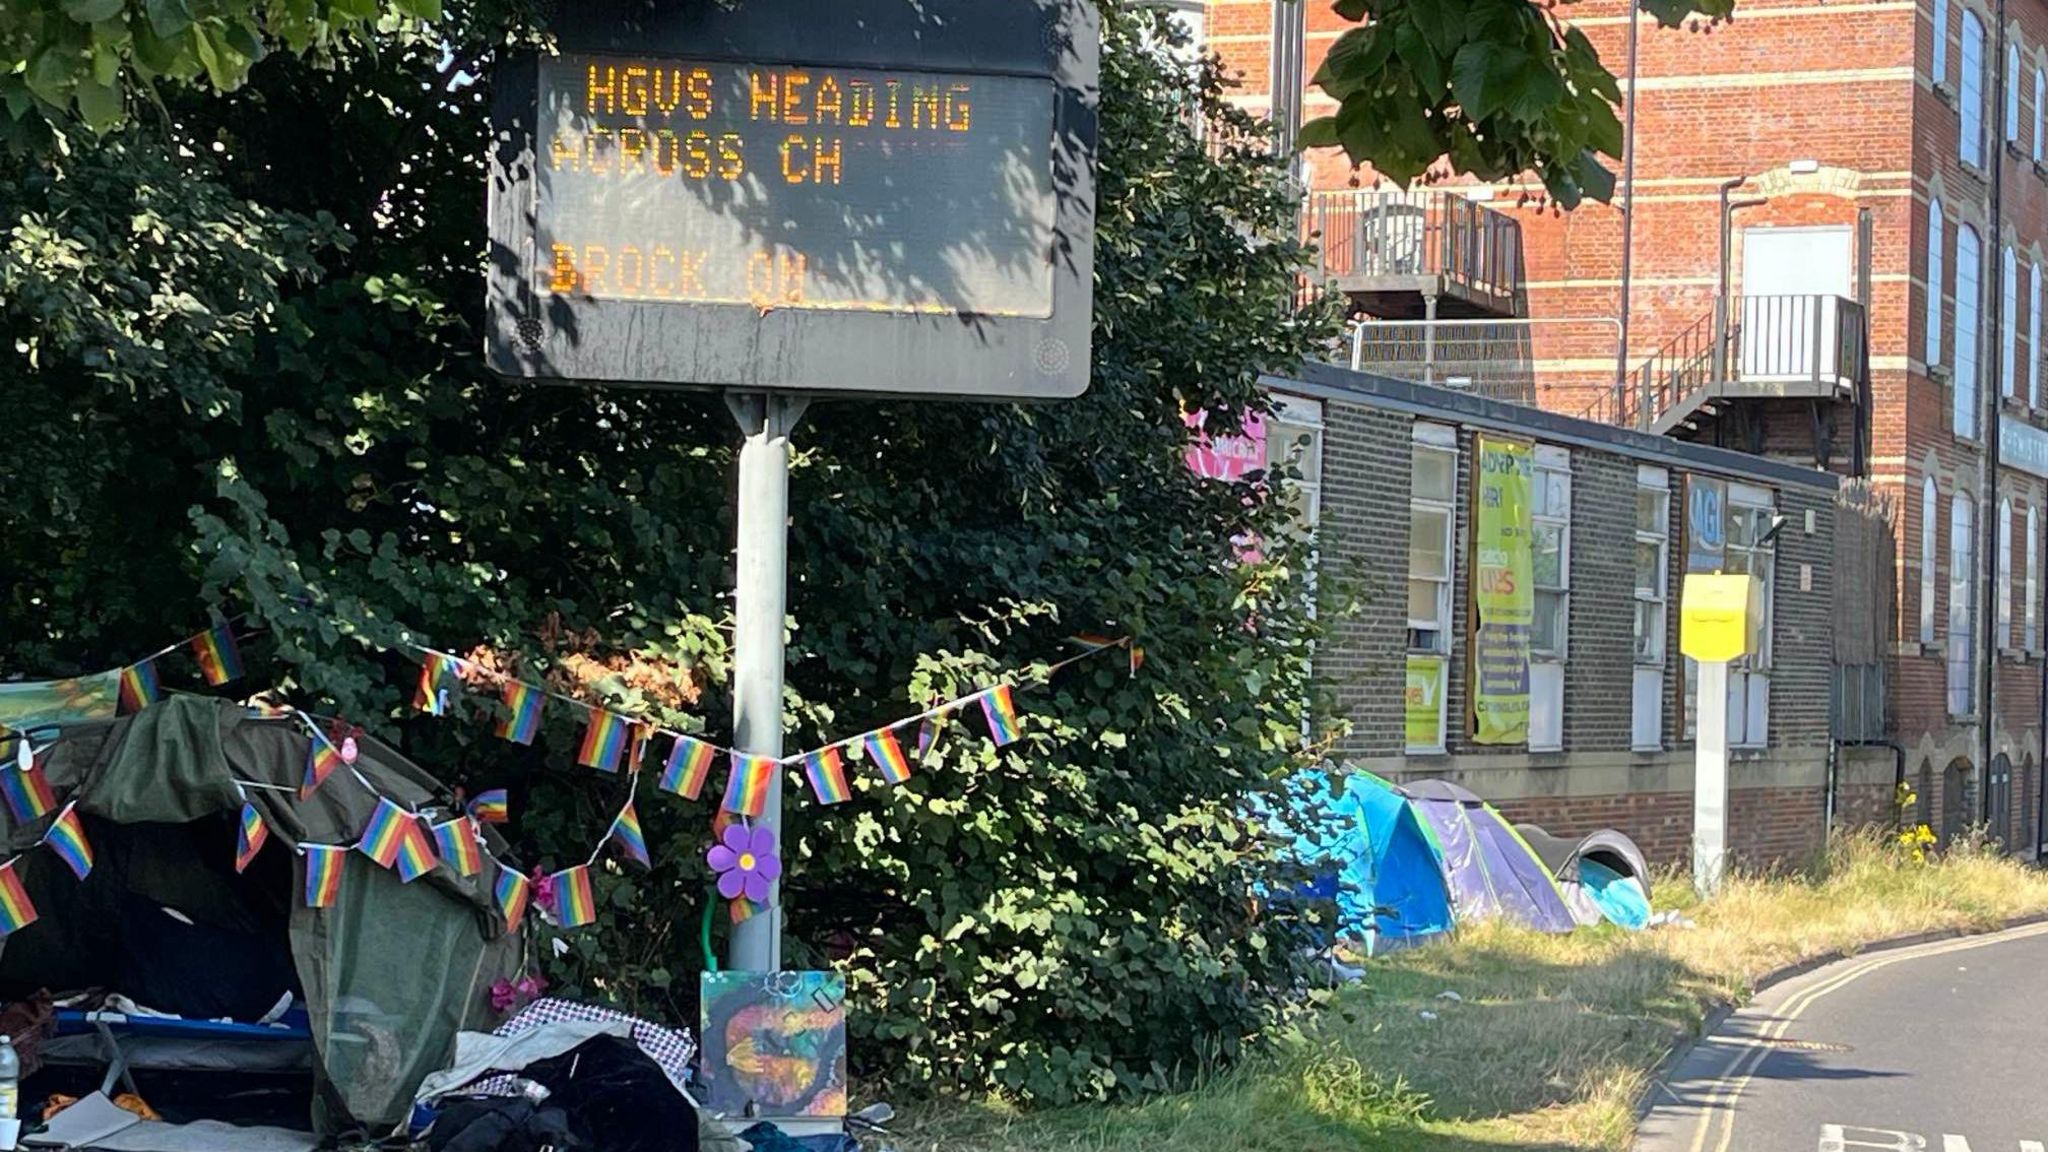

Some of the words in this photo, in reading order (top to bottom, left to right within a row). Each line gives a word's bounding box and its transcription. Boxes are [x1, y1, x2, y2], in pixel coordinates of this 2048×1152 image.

[587, 64, 713, 121] HGVS
[751, 72, 971, 132] HEADING
[552, 127, 744, 181] ACROSS
[781, 132, 842, 185] CH
